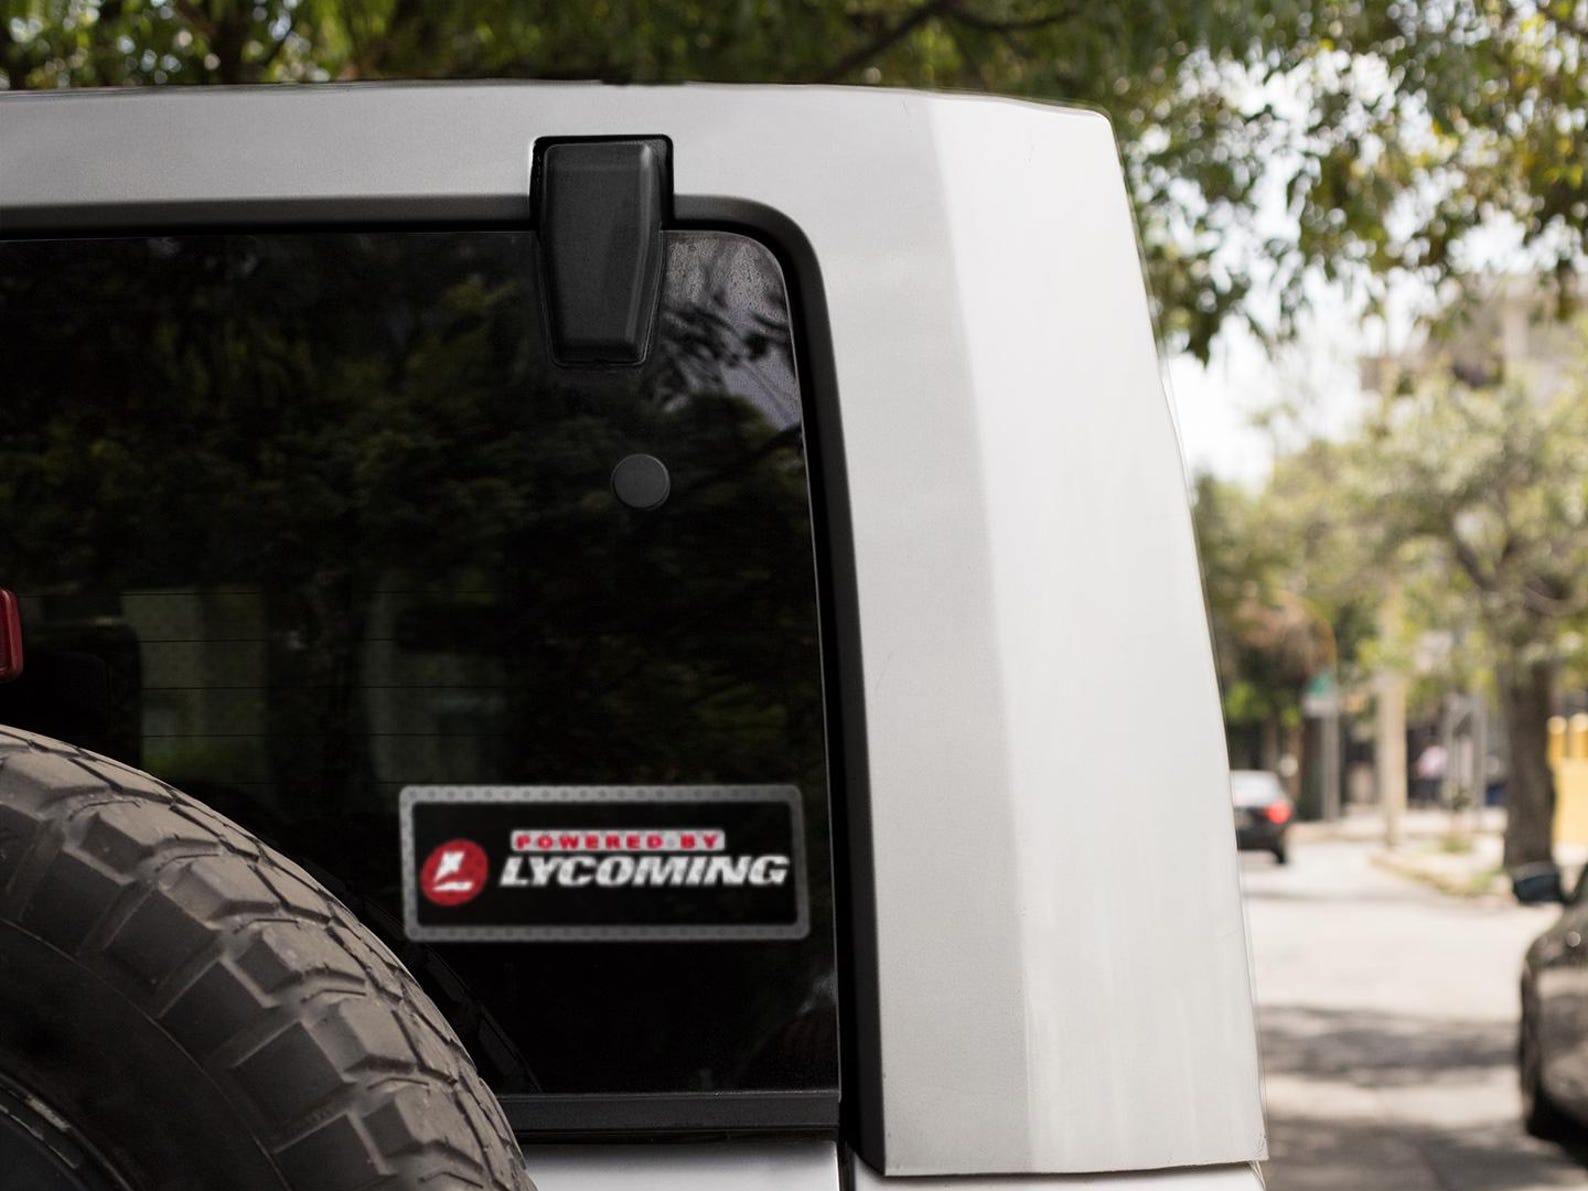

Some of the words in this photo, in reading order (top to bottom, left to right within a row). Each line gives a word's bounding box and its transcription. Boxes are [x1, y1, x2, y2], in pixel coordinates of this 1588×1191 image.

[515, 834, 664, 849] POWERED
[680, 834, 720, 849] BY
[499, 855, 790, 886] LYCOMING
